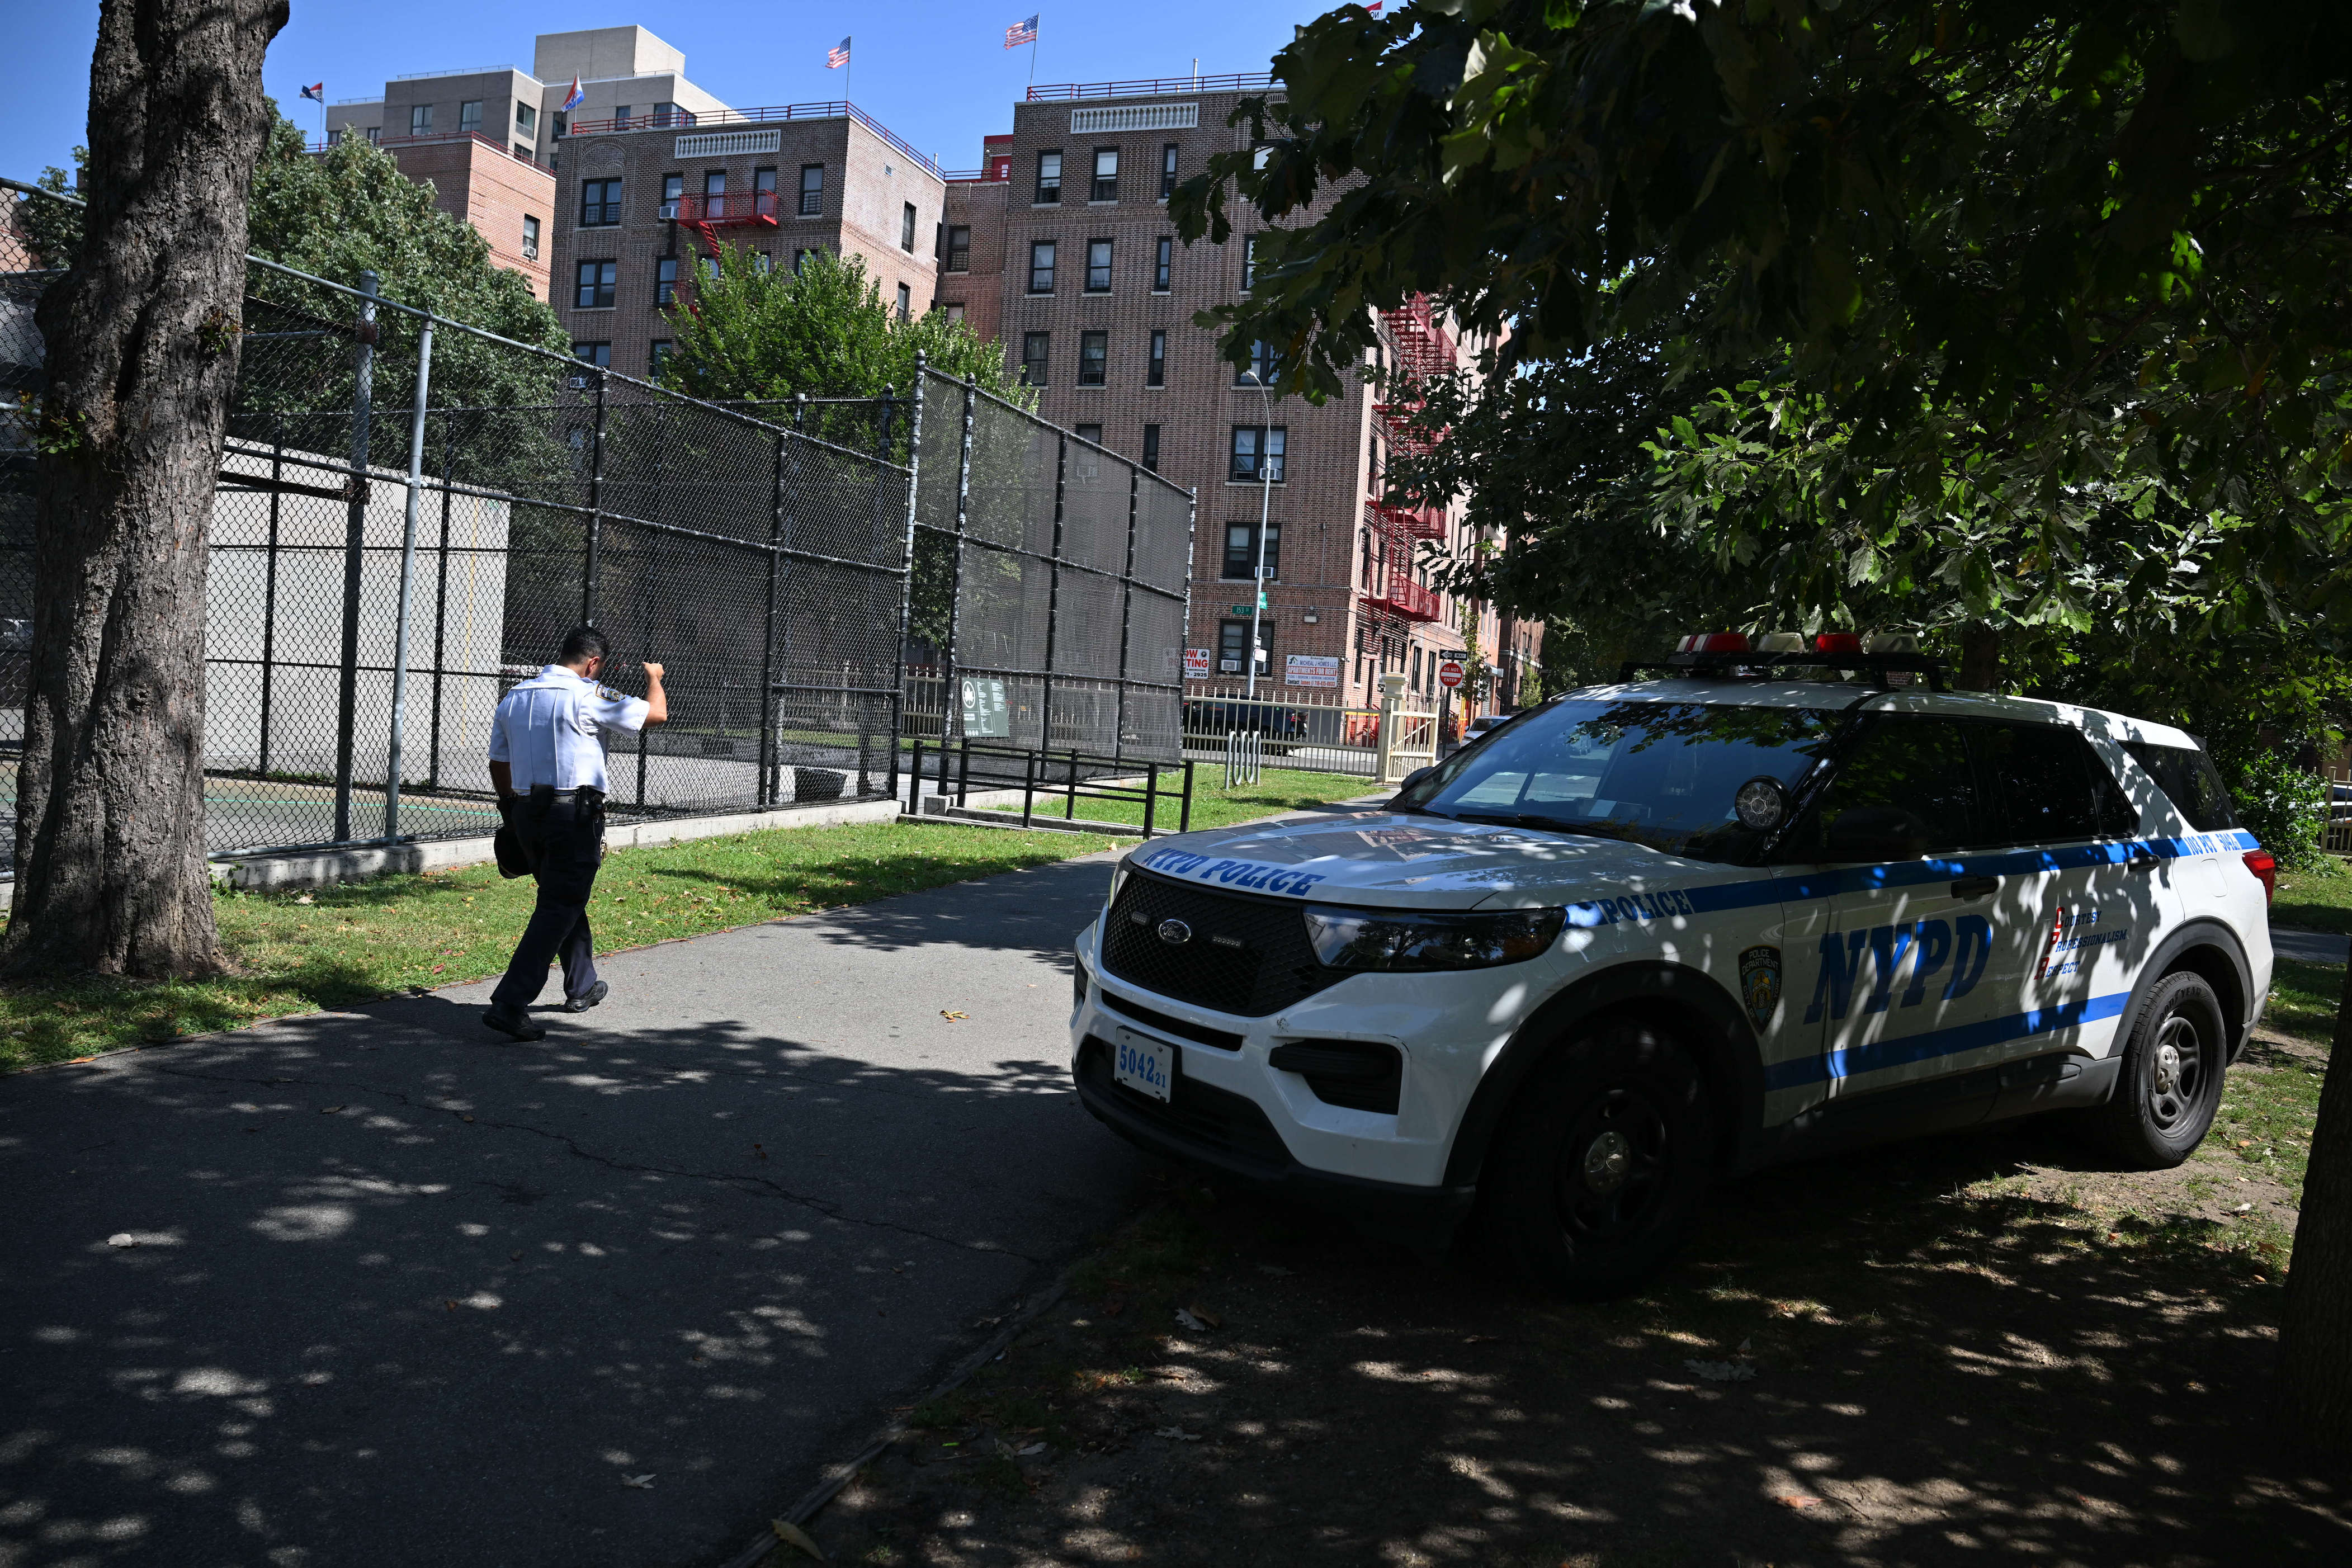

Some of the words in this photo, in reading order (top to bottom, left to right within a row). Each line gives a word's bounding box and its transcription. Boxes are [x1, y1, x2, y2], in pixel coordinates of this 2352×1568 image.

[1288, 666, 1316, 674] APARTMENTS
[2184, 835, 2203, 855] 103
[2197, 834, 2217, 853] PCT
[1142, 848, 1210, 874] NYPD
[1199, 859, 1327, 896] POLICE
[1599, 890, 1693, 923] POLICE
[1161, 923, 1182, 939] Ford
[1749, 949, 1769, 960] POLICE
[1742, 958, 1779, 975] DEPARTMENT
[1803, 914, 1991, 1024] NYPD
[1120, 1044, 1155, 1083] 5042
[1155, 1072, 1165, 1088] 21
